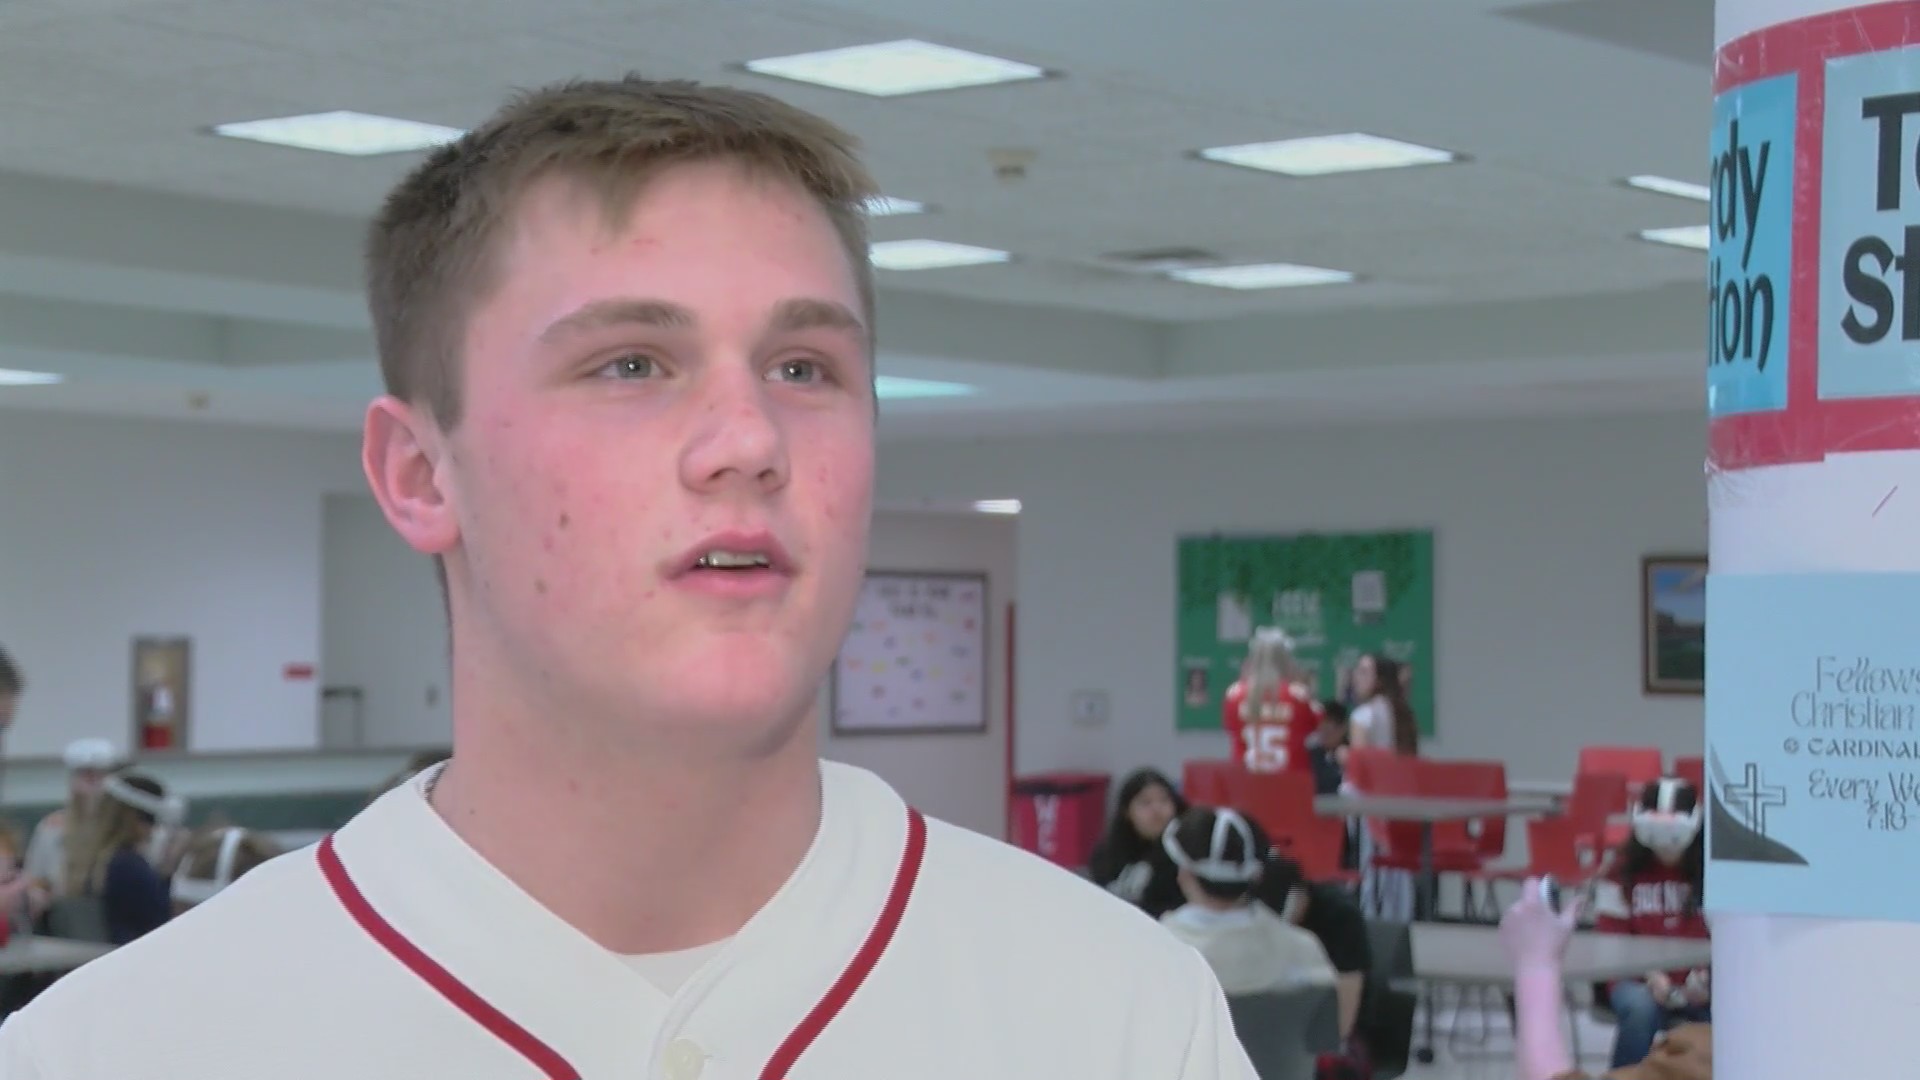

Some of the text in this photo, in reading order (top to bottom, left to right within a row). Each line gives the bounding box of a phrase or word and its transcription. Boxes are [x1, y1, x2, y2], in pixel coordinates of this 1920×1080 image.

[1862, 91, 1920, 212] T
[1791, 690, 1914, 731] Christian
[1241, 724, 1289, 772] 15
[1808, 768, 1879, 806] Every
